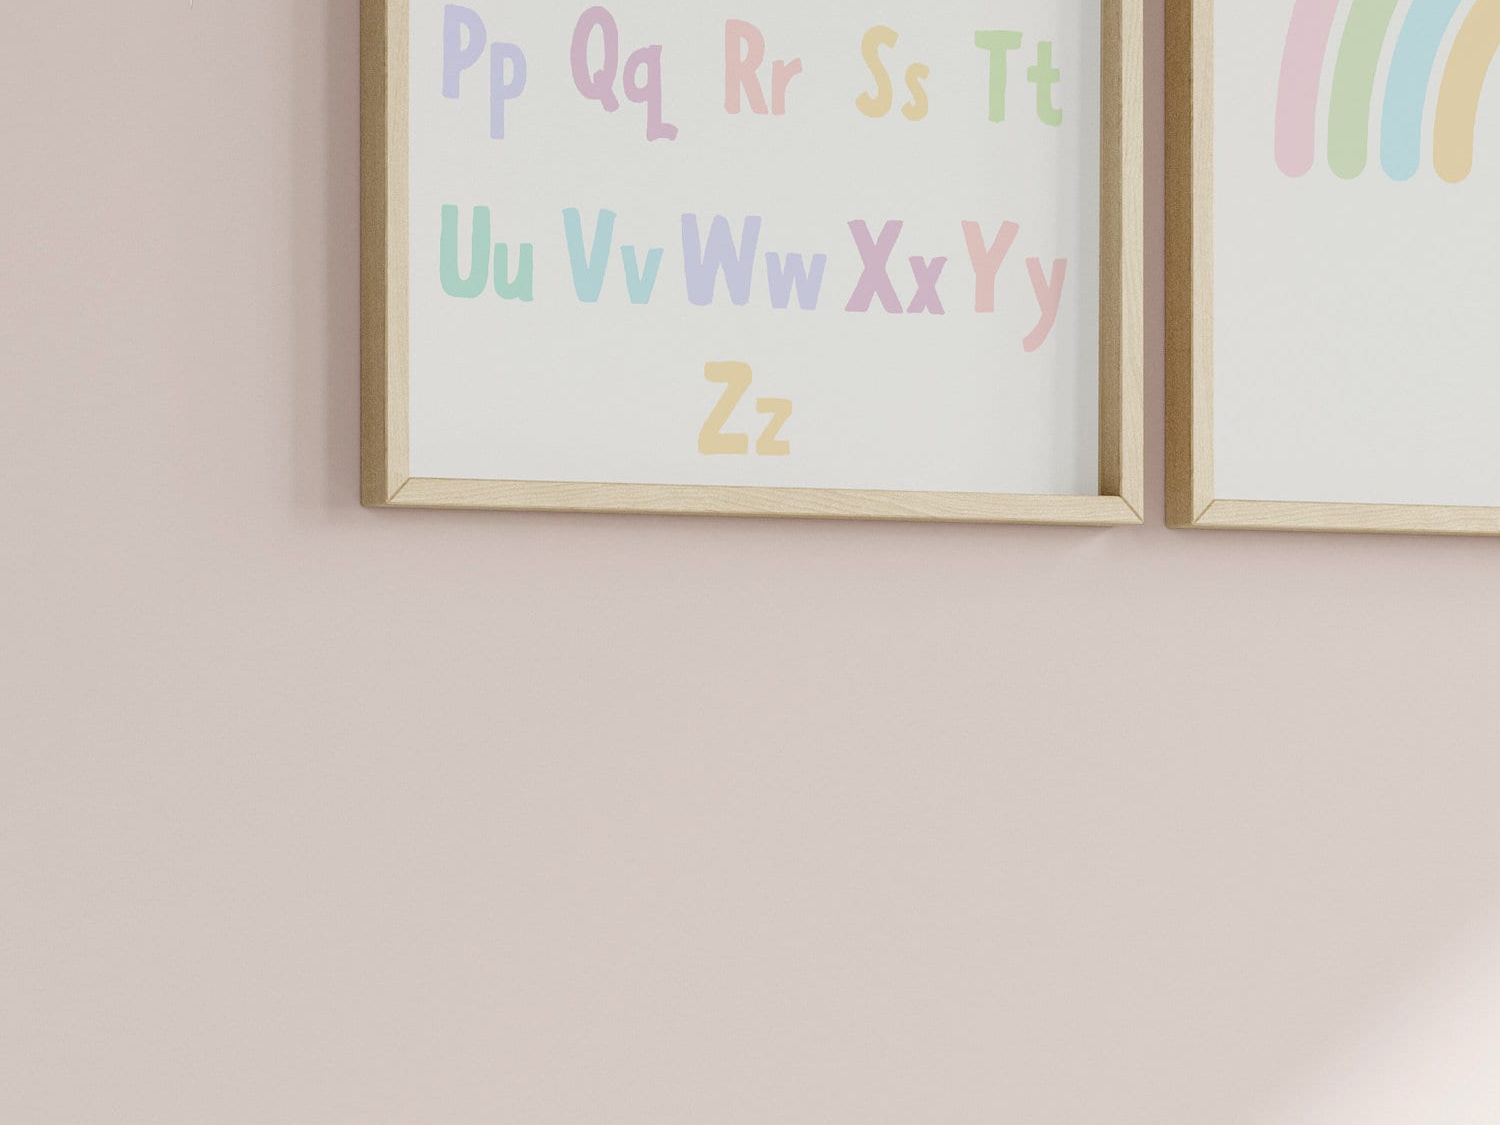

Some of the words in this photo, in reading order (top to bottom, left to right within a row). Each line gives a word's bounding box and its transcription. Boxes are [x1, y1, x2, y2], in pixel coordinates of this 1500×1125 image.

[442, 3, 527, 140] Pp
[570, 6, 678, 141] Qq
[724, 19, 803, 115] Rr
[854, 24, 930, 122] Ss
[974, 28, 1064, 127] Tt
[439, 204, 534, 303] Uu
[561, 207, 663, 305] Vv
[681, 213, 827, 310] Ww
[846, 219, 948, 315] Xx
[961, 221, 1068, 352] Yy
[696, 360, 793, 457] Zz
